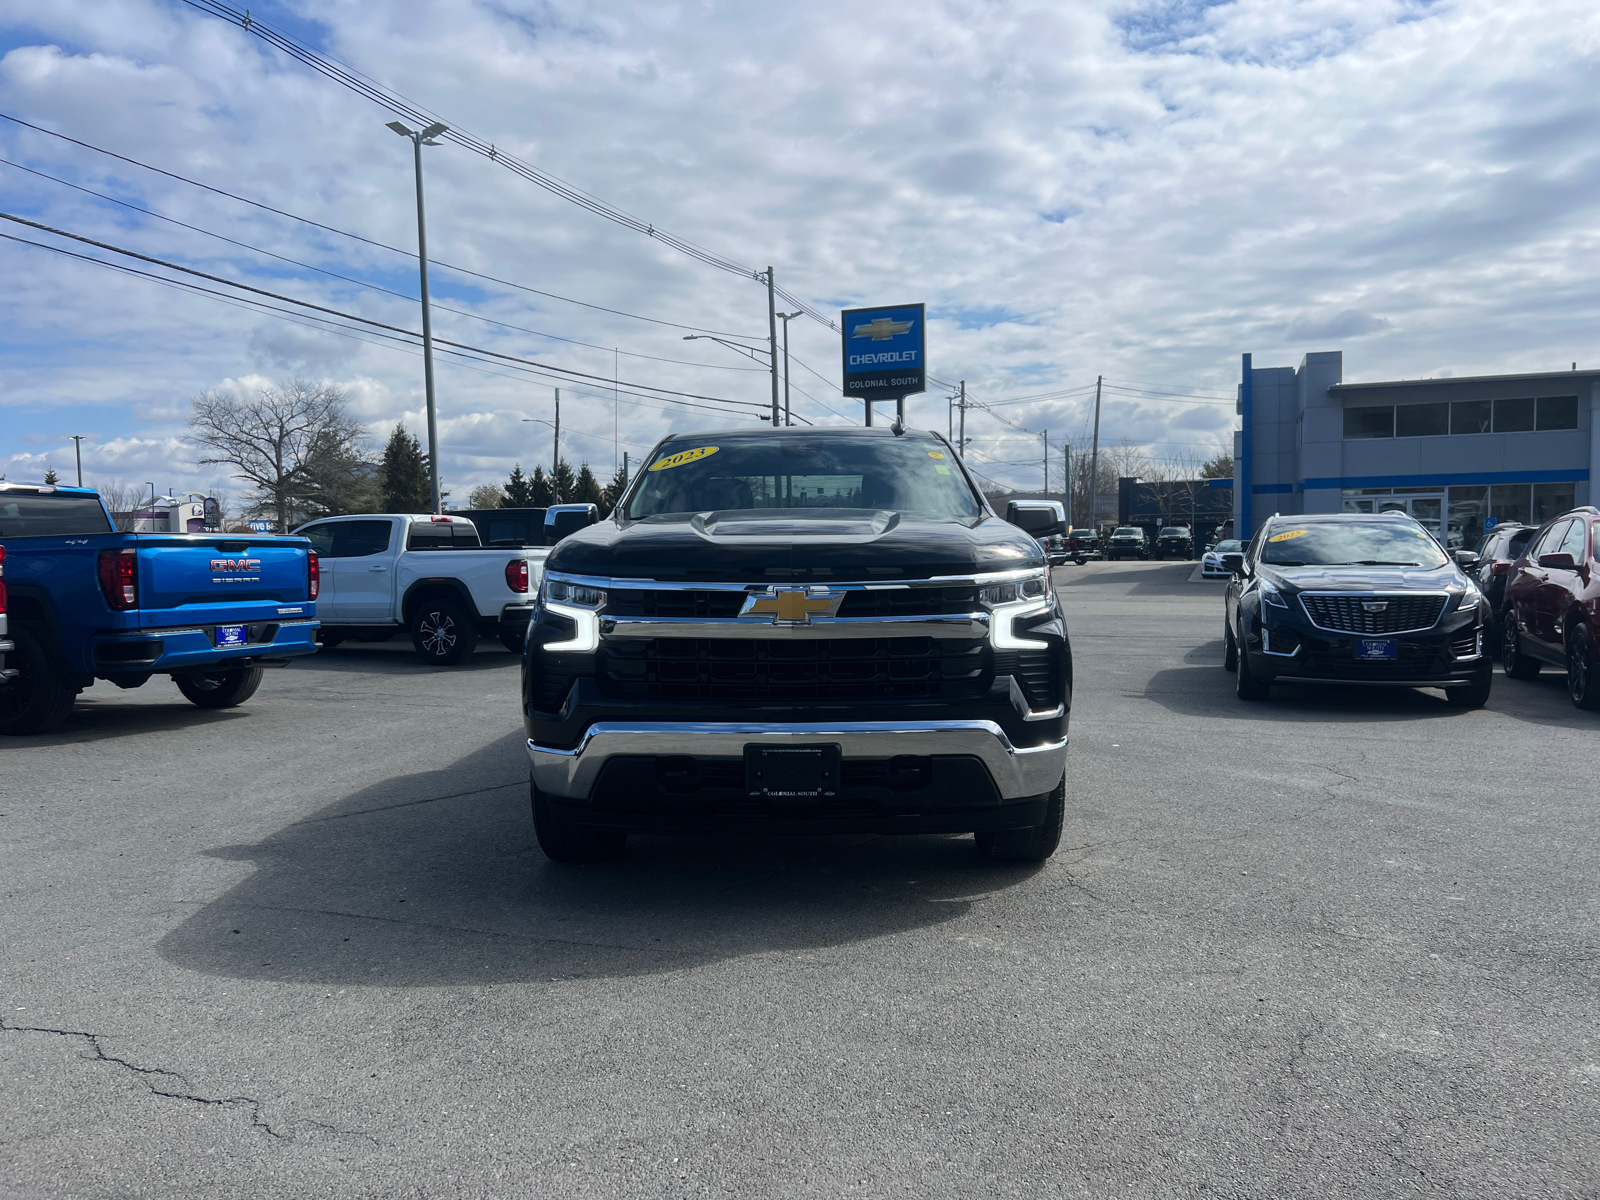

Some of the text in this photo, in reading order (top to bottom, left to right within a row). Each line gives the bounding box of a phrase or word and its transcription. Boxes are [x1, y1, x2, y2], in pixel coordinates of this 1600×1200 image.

[849, 350, 917, 365] CHEVROLET
[849, 377, 918, 389] COLONIAL SOUTH
[661, 448, 706, 468] 2023
[210, 559, 261, 571] GMC
